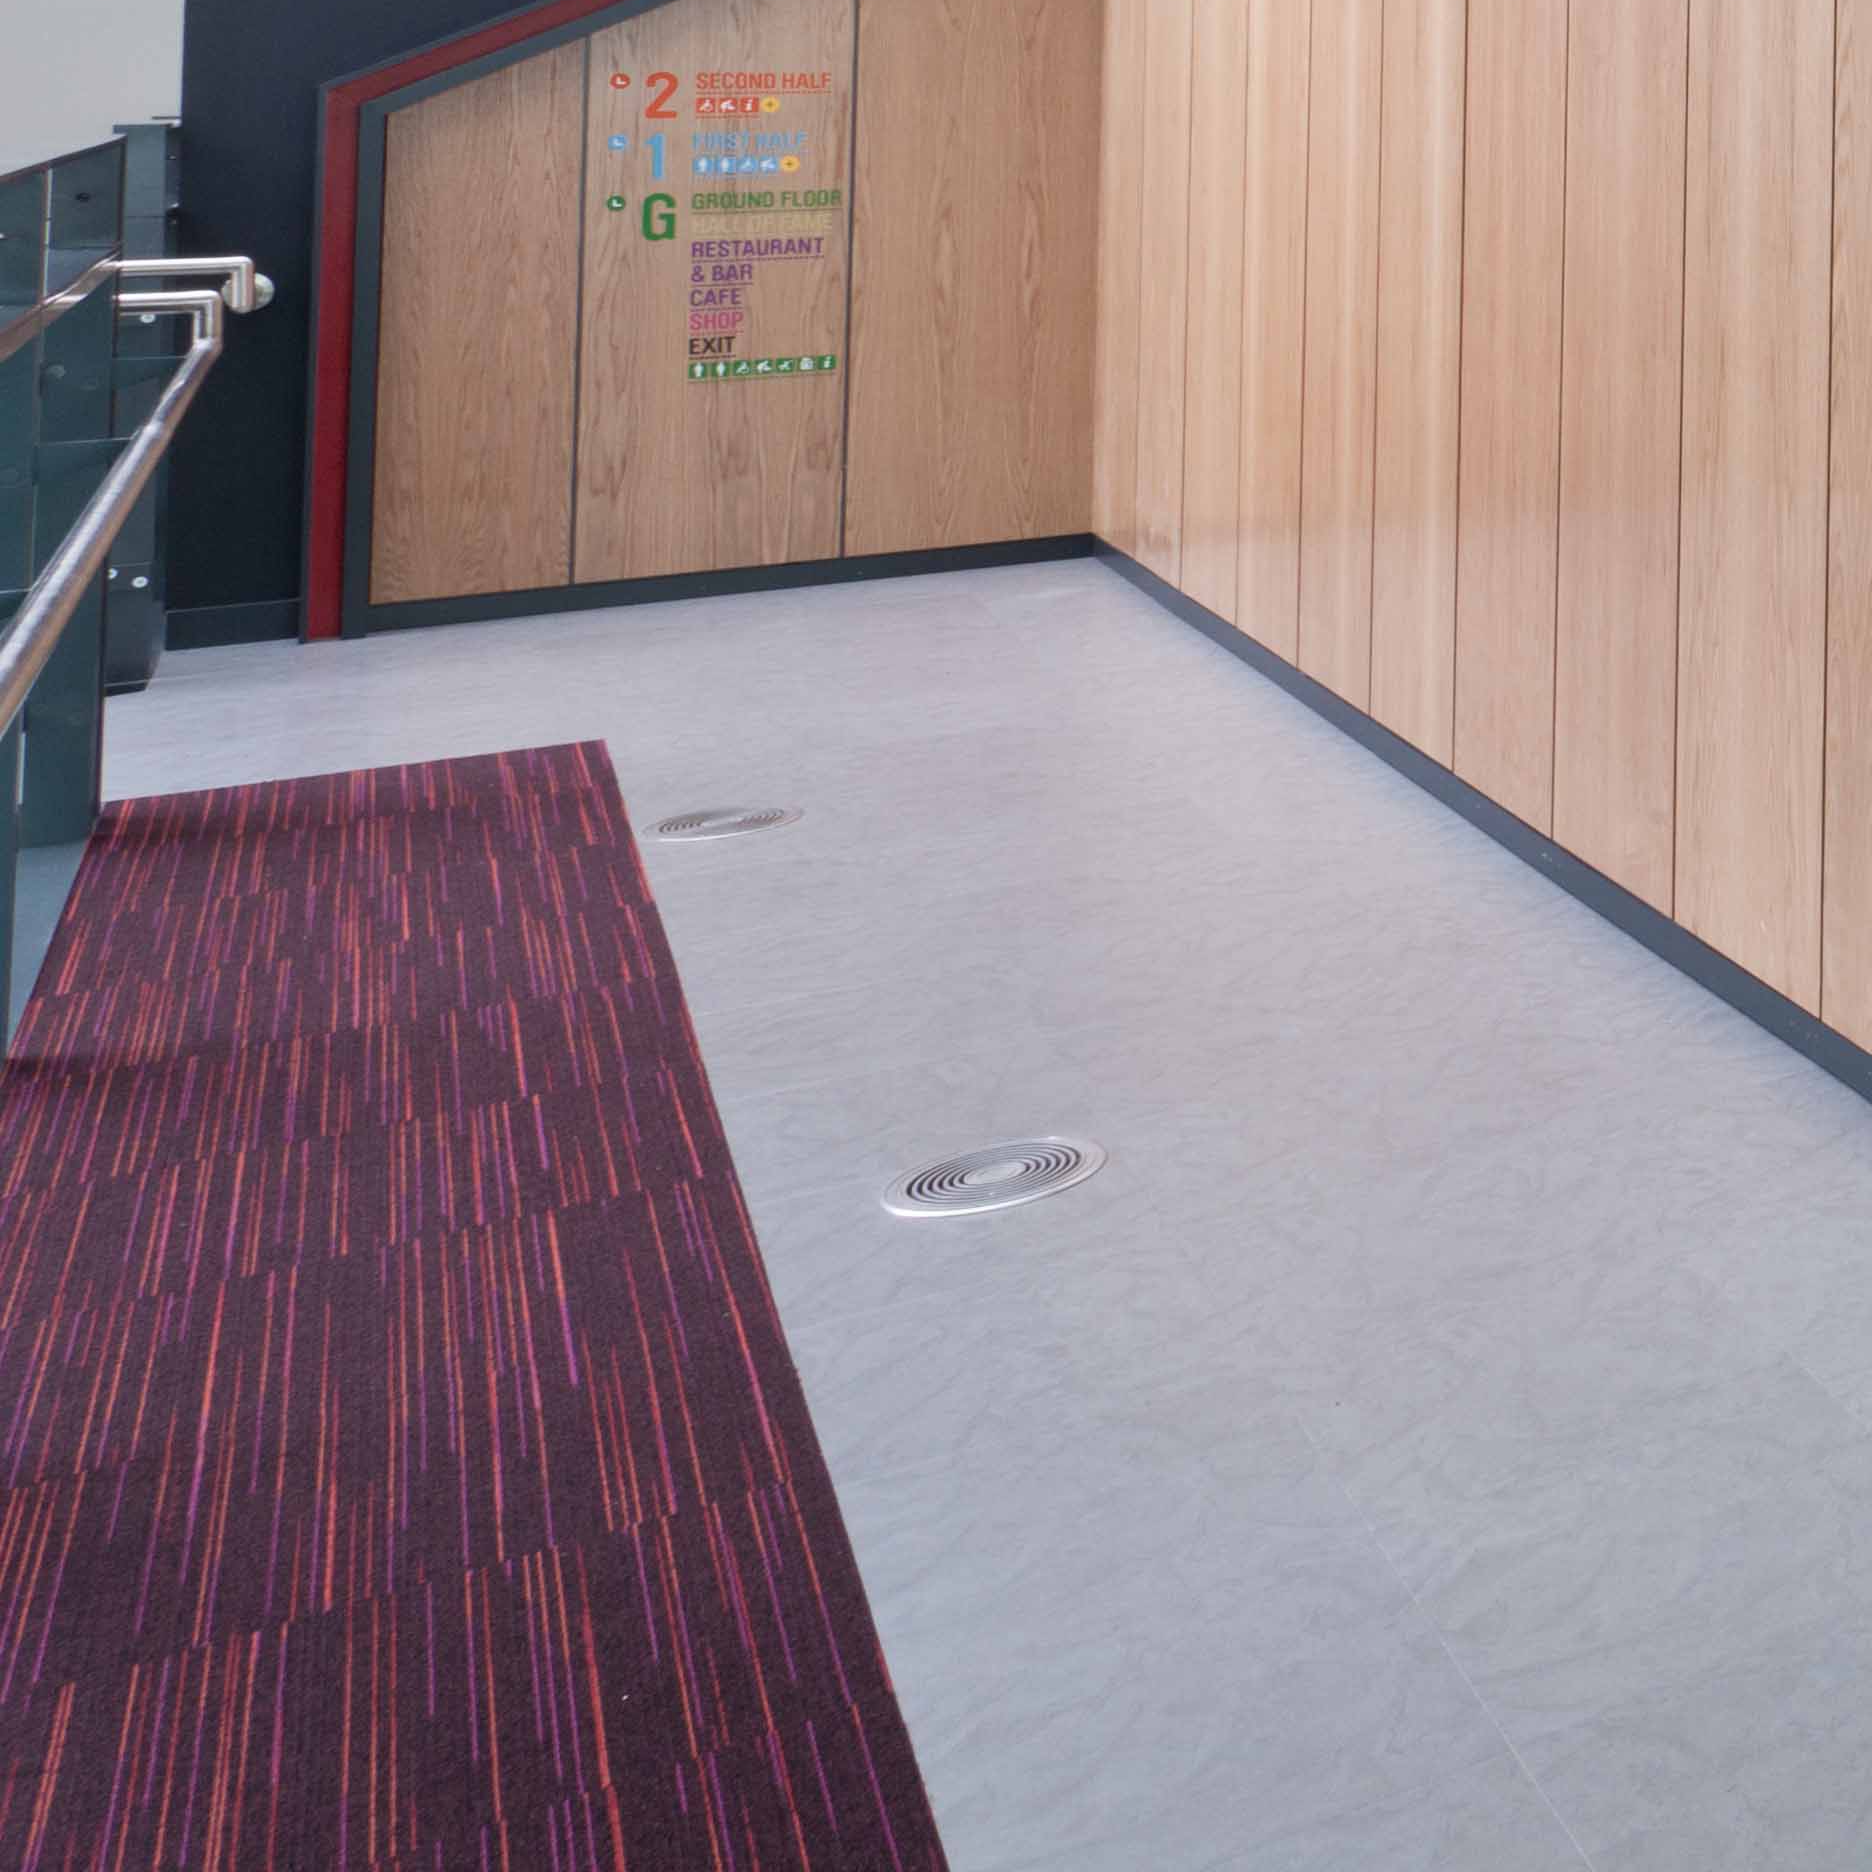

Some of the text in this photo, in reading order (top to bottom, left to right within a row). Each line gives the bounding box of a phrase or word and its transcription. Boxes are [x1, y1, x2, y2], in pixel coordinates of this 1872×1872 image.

[696, 71, 832, 90] SECOND HALF
[645, 72, 679, 119] 2
[645, 132, 665, 180] 1
[692, 190, 841, 211] GROUND FLOOR
[641, 192, 677, 241] G
[691, 237, 824, 257] RESTAURANT
[691, 264, 752, 283] & BAR
[690, 288, 742, 307] CAFE
[690, 312, 743, 331] SHOP
[689, 336, 736, 356] EXIT
